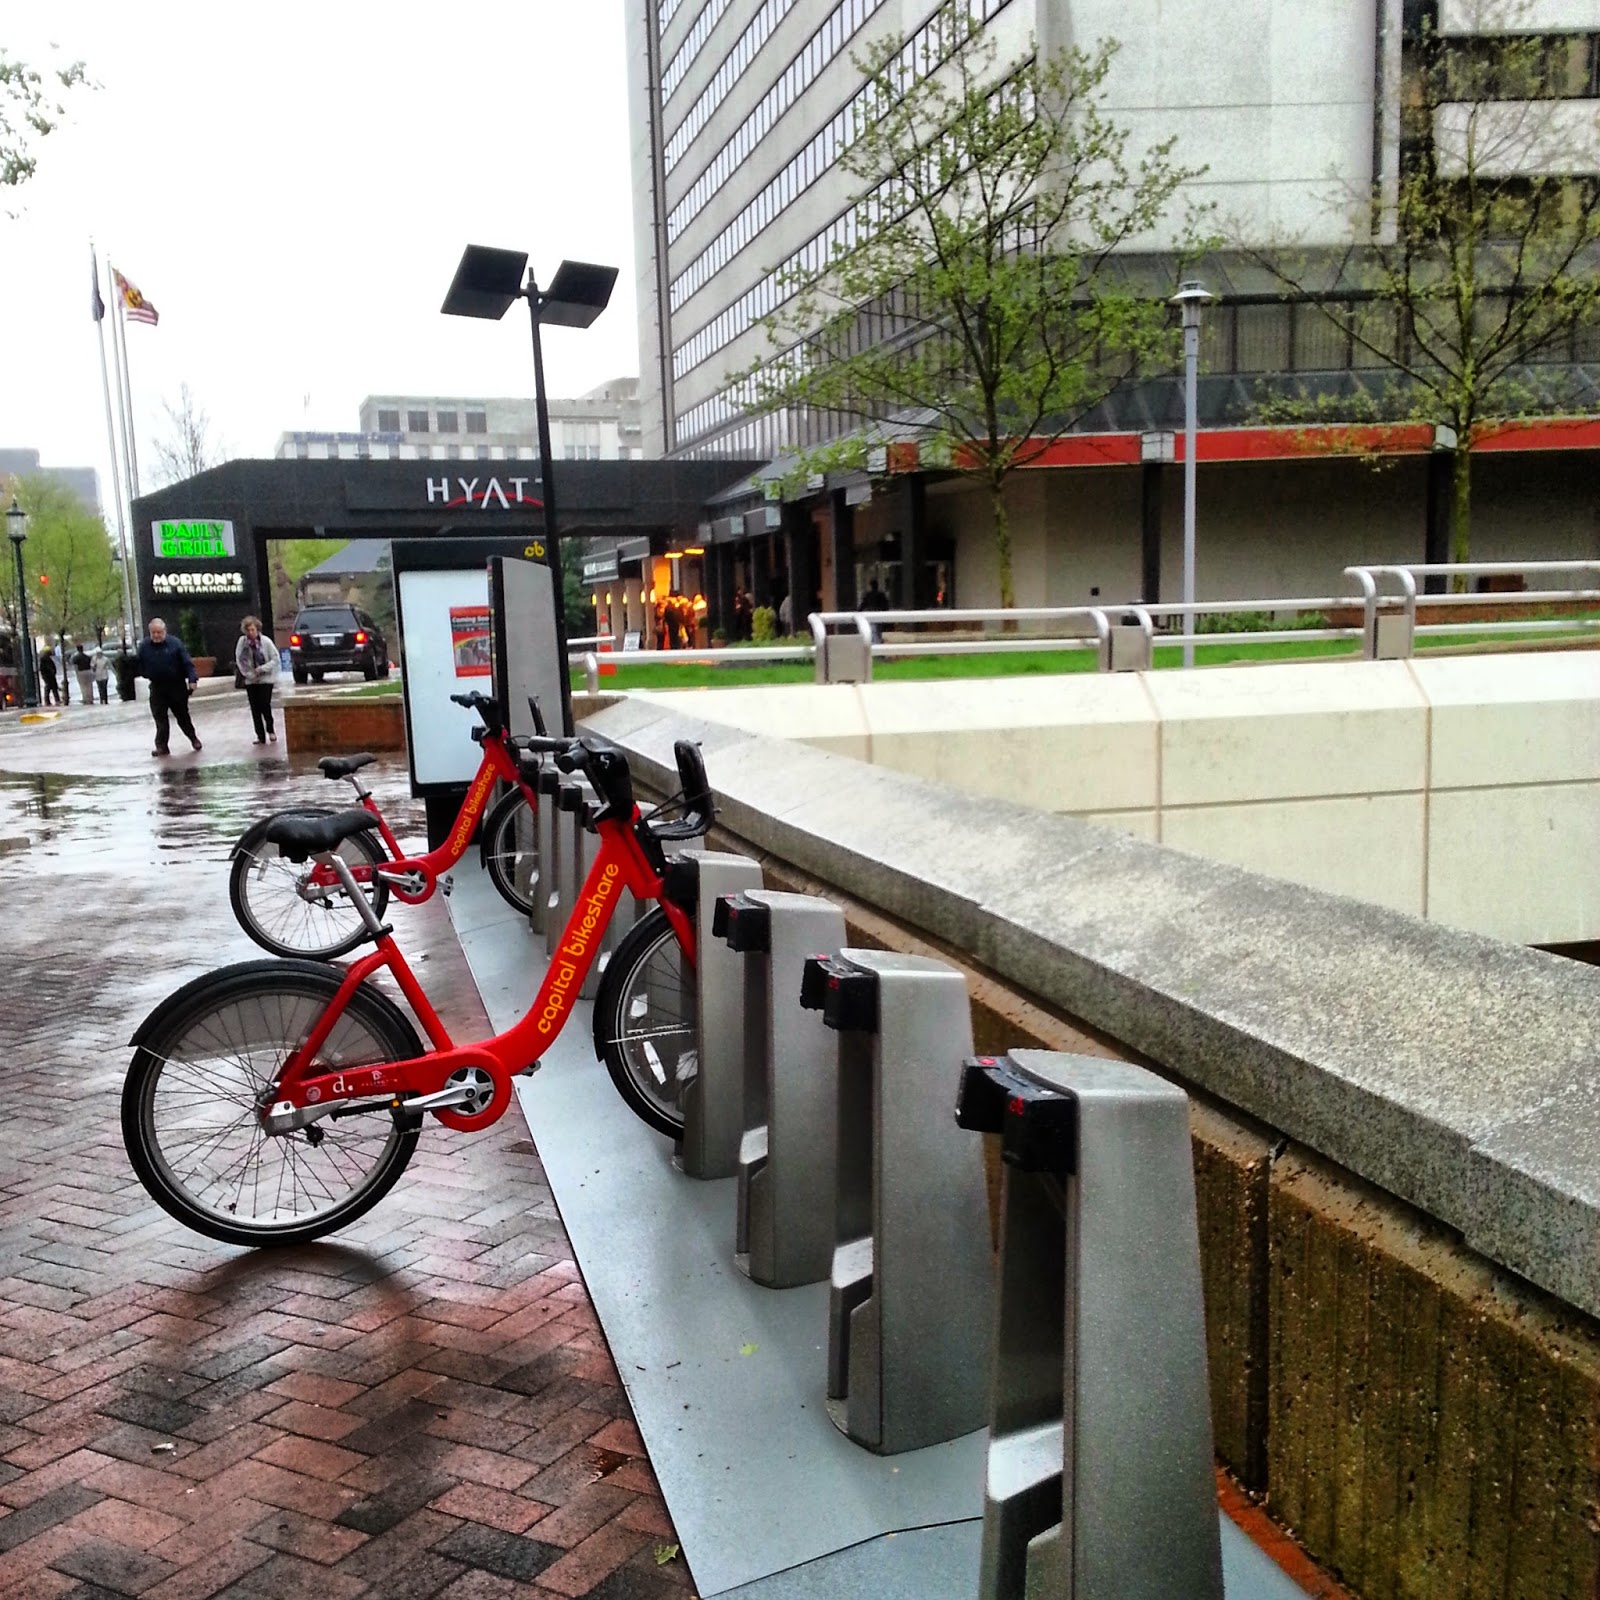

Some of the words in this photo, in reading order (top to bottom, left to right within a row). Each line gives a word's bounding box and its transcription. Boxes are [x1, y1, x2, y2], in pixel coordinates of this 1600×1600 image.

[426, 477, 543, 509] HYAT
[160, 522, 224, 539] DAILY
[161, 540, 228, 557] GRILL
[152, 572, 243, 586] MORTON'S
[177, 585, 244, 593] STEAKHOUSE
[451, 815, 473, 856] capital
[464, 763, 496, 815] bikeshare
[537, 959, 577, 1034] capital
[562, 863, 619, 957] bikeshare
